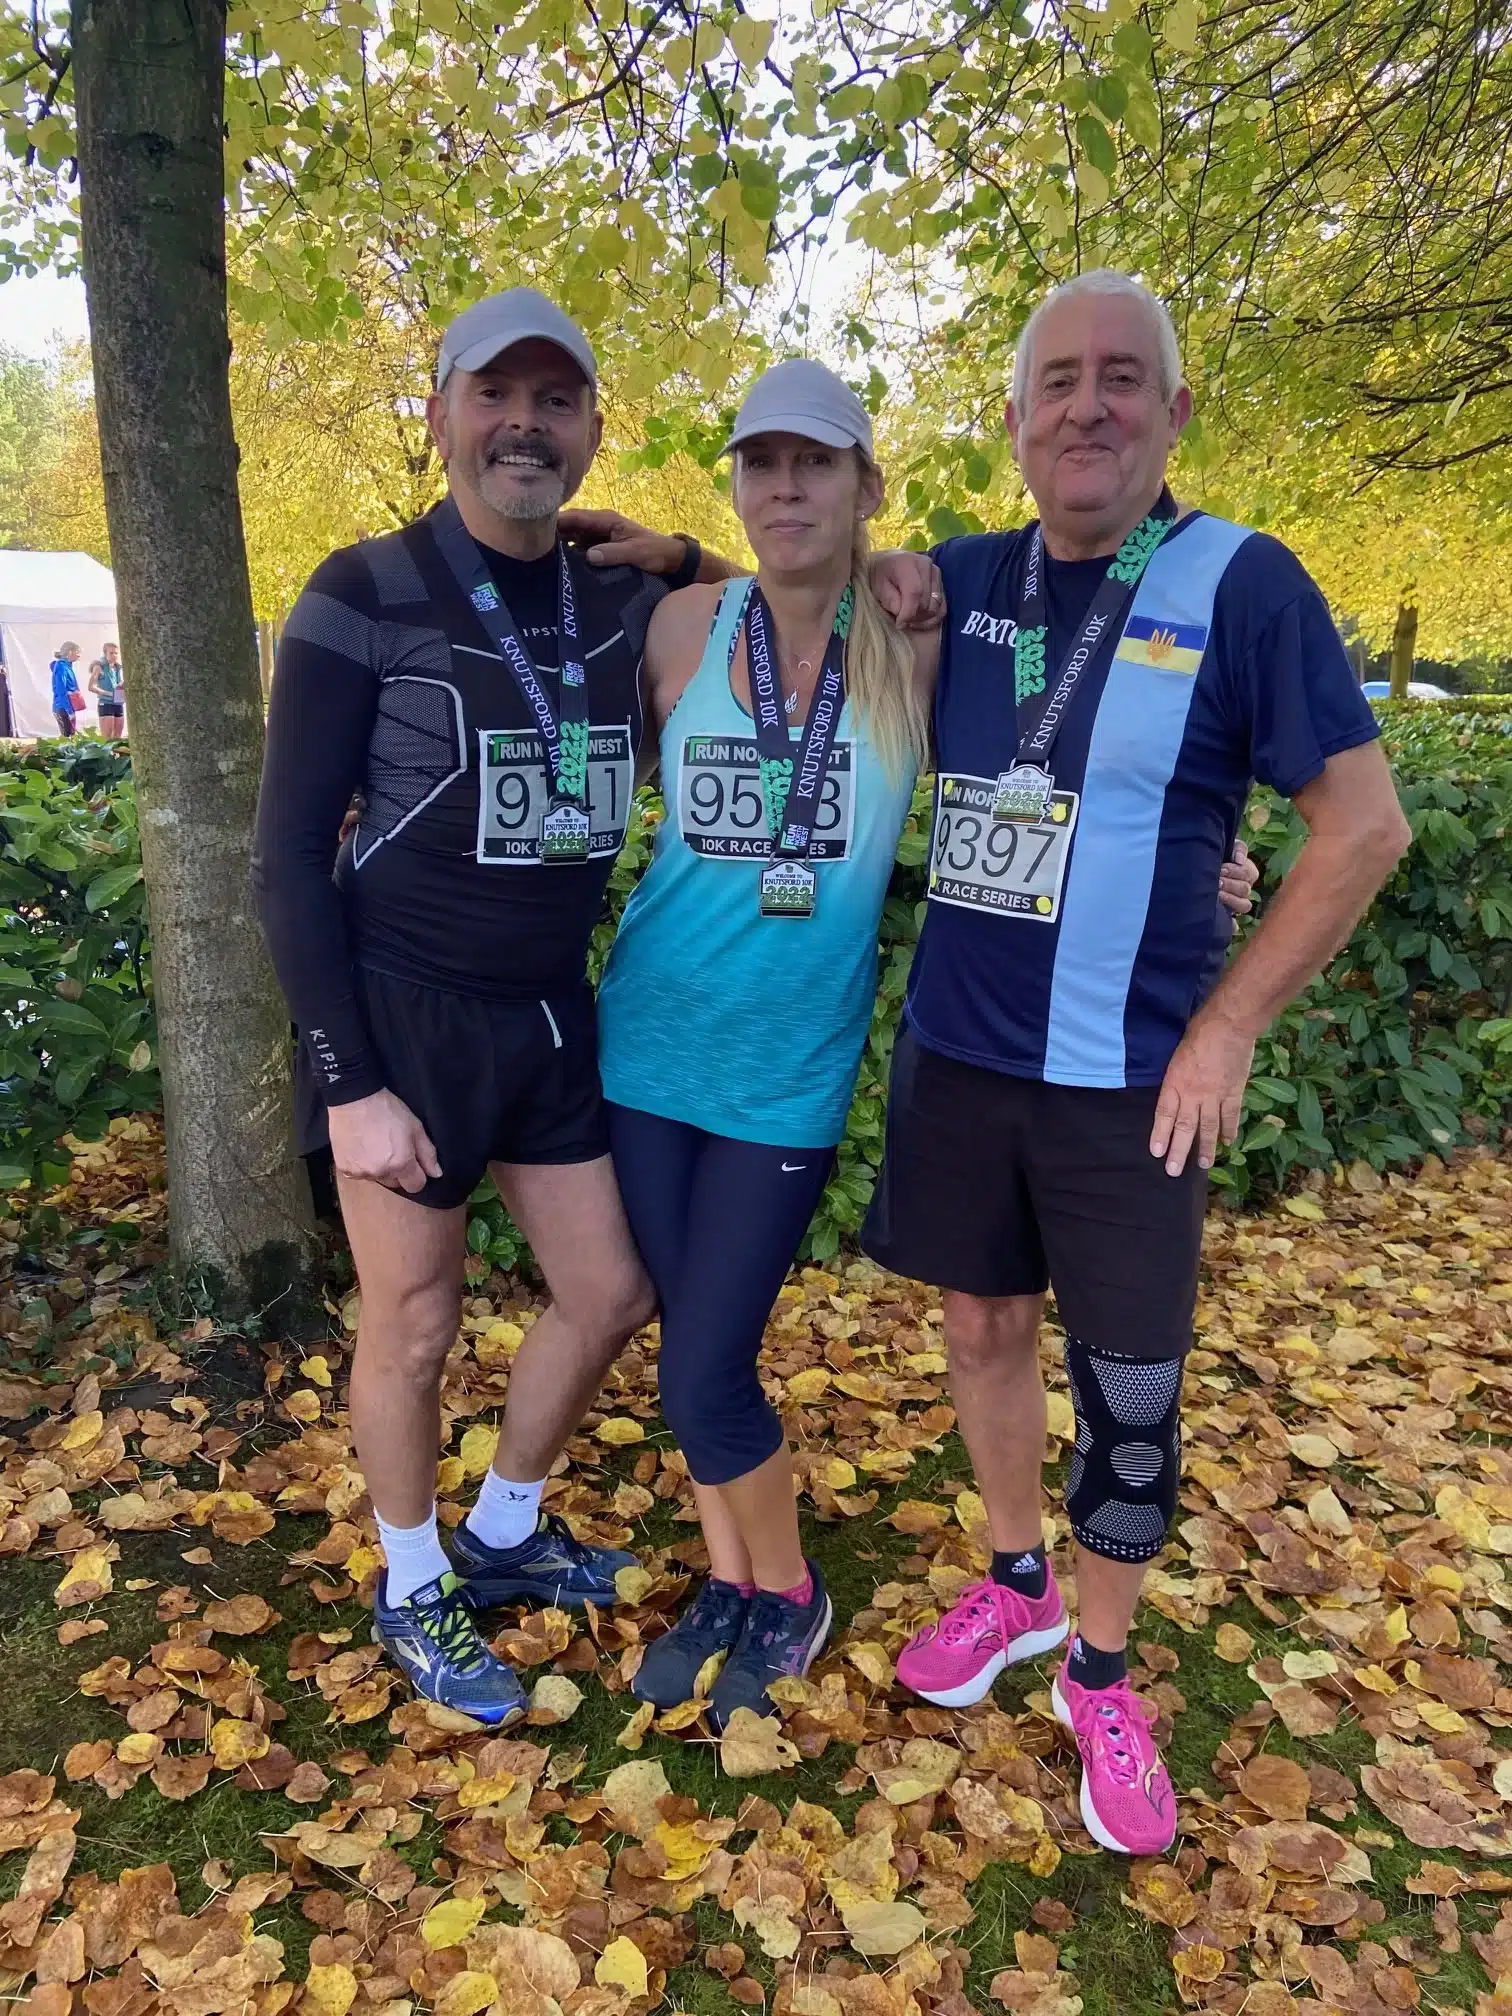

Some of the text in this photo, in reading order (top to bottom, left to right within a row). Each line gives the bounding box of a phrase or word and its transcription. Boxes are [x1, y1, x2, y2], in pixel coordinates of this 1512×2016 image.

[560, 540, 578, 639] KNUTSFO
[1024, 570, 1038, 601] 10K
[500, 634, 557, 739] KNUTSFORD
[1030, 613, 1109, 750] KNUTSFORD 10K
[759, 697, 780, 728] 10K
[796, 667, 842, 799] KNUTSFORD 10K
[501, 741, 532, 760] RUN
[556, 720, 581, 795] 2022
[696, 744, 729, 761] RUN
[495, 767, 616, 830] 91
[690, 772, 842, 831] 953
[963, 787, 995, 807] NOR
[505, 841, 531, 855] 10K
[589, 834, 614, 848] RIES
[701, 838, 771, 854] 10K RACE
[785, 824, 798, 845] RUN
[935, 813, 1057, 884] 9397
[942, 882, 977, 900] RACE
[981, 888, 1032, 910] SERIES
